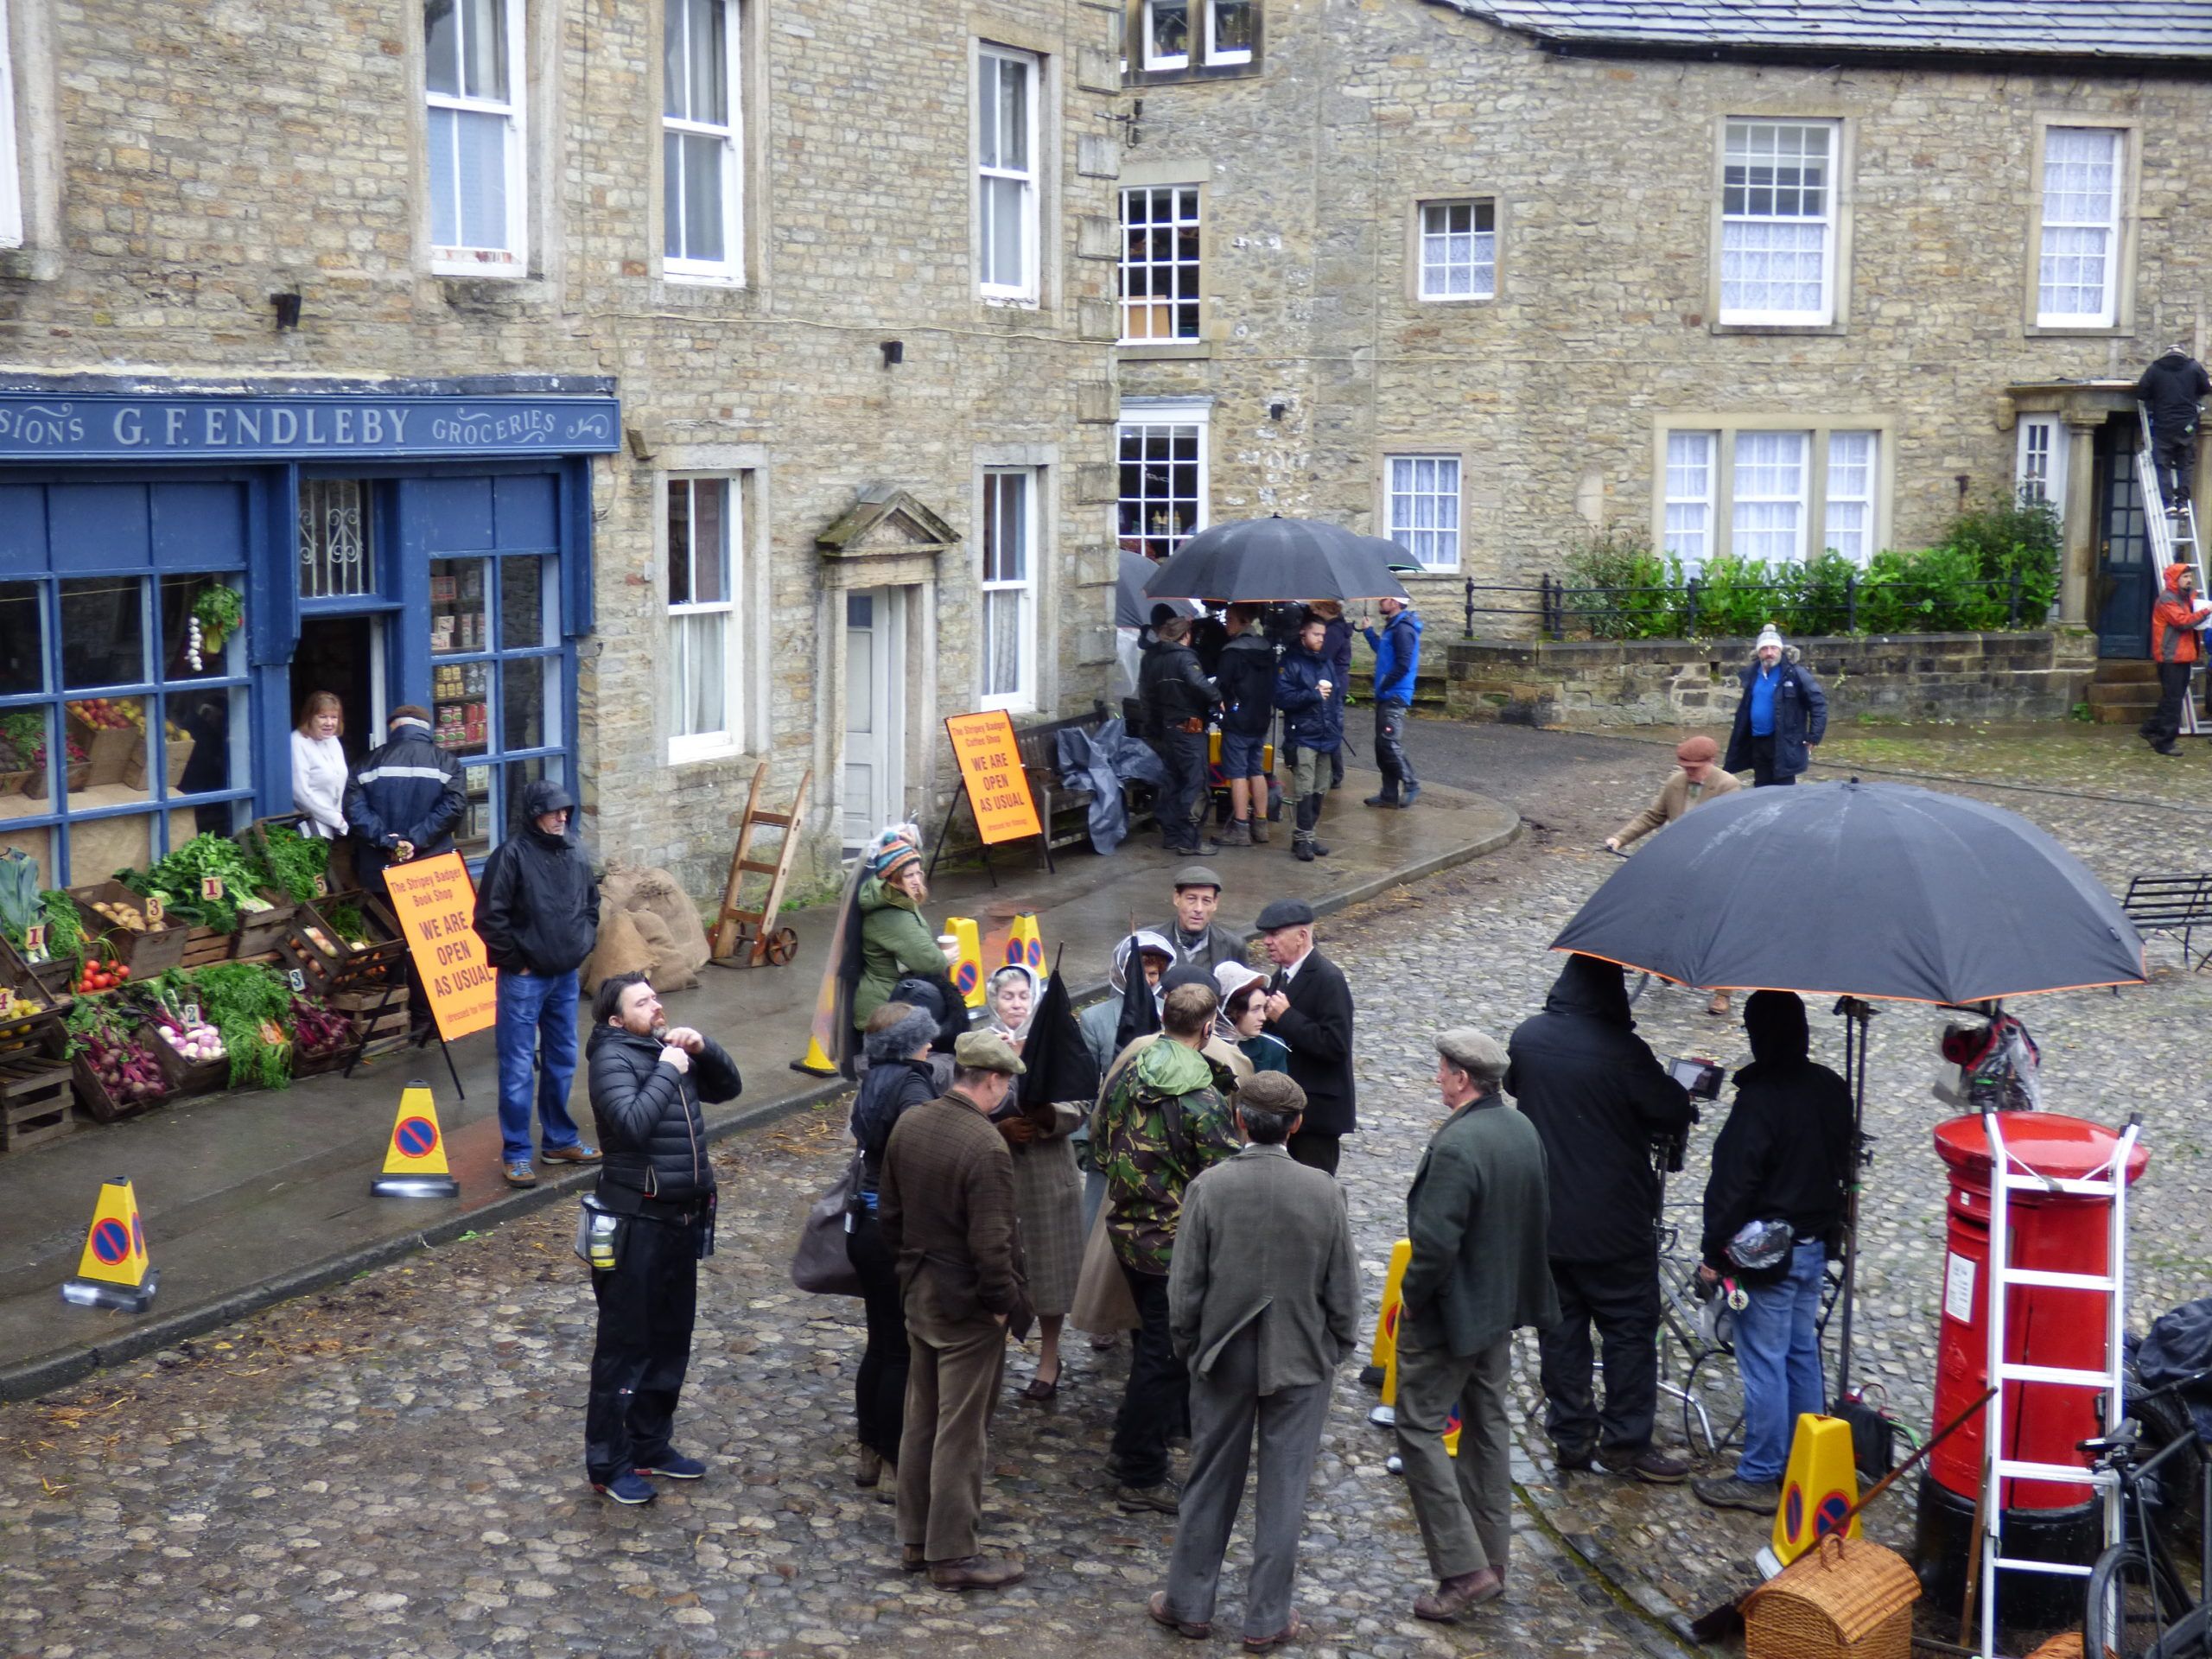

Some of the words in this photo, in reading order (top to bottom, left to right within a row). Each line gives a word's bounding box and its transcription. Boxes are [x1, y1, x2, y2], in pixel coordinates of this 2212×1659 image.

[113, 407, 150, 445] G.
[165, 408, 188, 445] F.
[205, 408, 410, 445] ENDLEBY
[432, 410, 556, 445] GROCERIES
[970, 756, 988, 772] WE
[990, 753, 1009, 767] ARE
[982, 773, 1009, 791] OPEN
[980, 797, 993, 812] AS
[994, 792, 1025, 810] USUAL
[205, 879, 218, 896] 1
[390, 881, 406, 893] The
[406, 875, 435, 890] Stripey
[434, 868, 461, 882] Badger
[412, 893, 434, 907] Book
[433, 888, 454, 901] Shop
[149, 899, 159, 916] 3
[419, 918, 442, 941] WE
[444, 911, 469, 935] ARE
[29, 928, 39, 944] 1
[436, 939, 472, 966] OPEN
[291, 971, 302, 988] 3
[434, 976, 452, 998] AS
[453, 963, 494, 992] USUAL
[187, 1006, 197, 1024] 2
